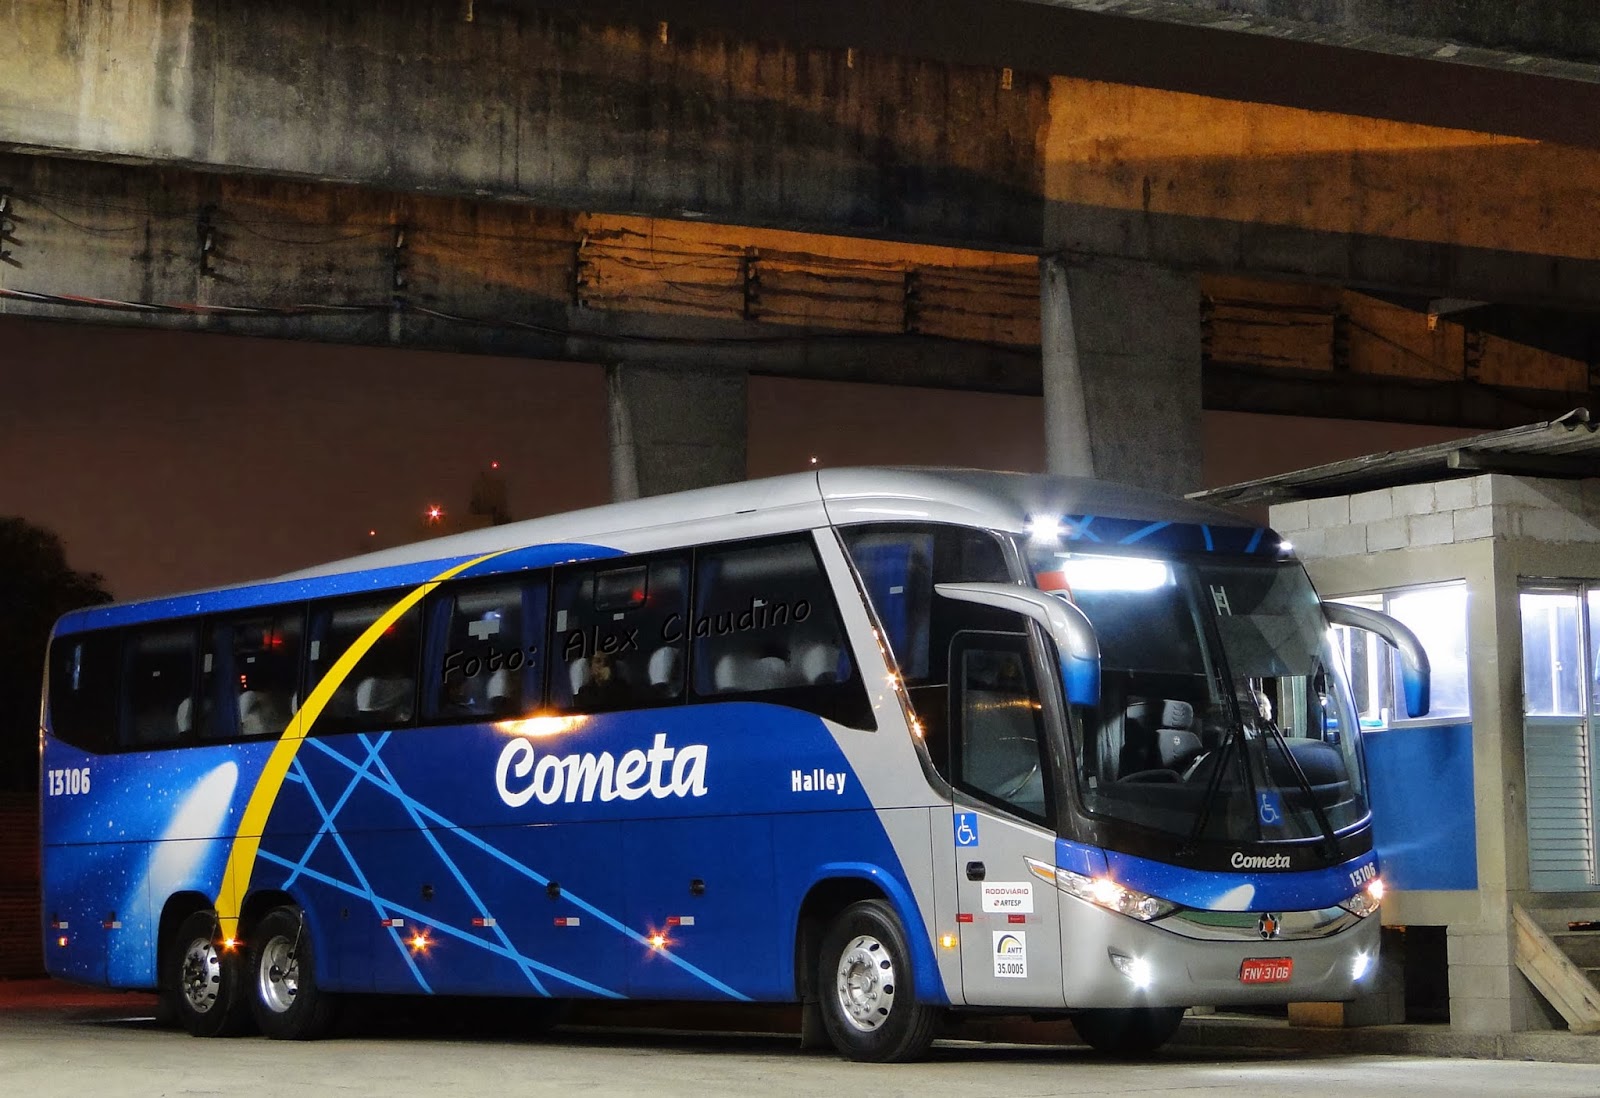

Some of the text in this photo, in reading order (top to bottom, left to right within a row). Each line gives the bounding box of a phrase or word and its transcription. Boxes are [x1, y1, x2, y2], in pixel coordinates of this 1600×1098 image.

[48, 767, 91, 796] 13106
[495, 732, 709, 808] Cometa
[791, 768, 847, 795] Halley
[1230, 851, 1291, 869] Cometa
[1349, 861, 1376, 888] 13106
[997, 963, 1024, 975] 35.0005
